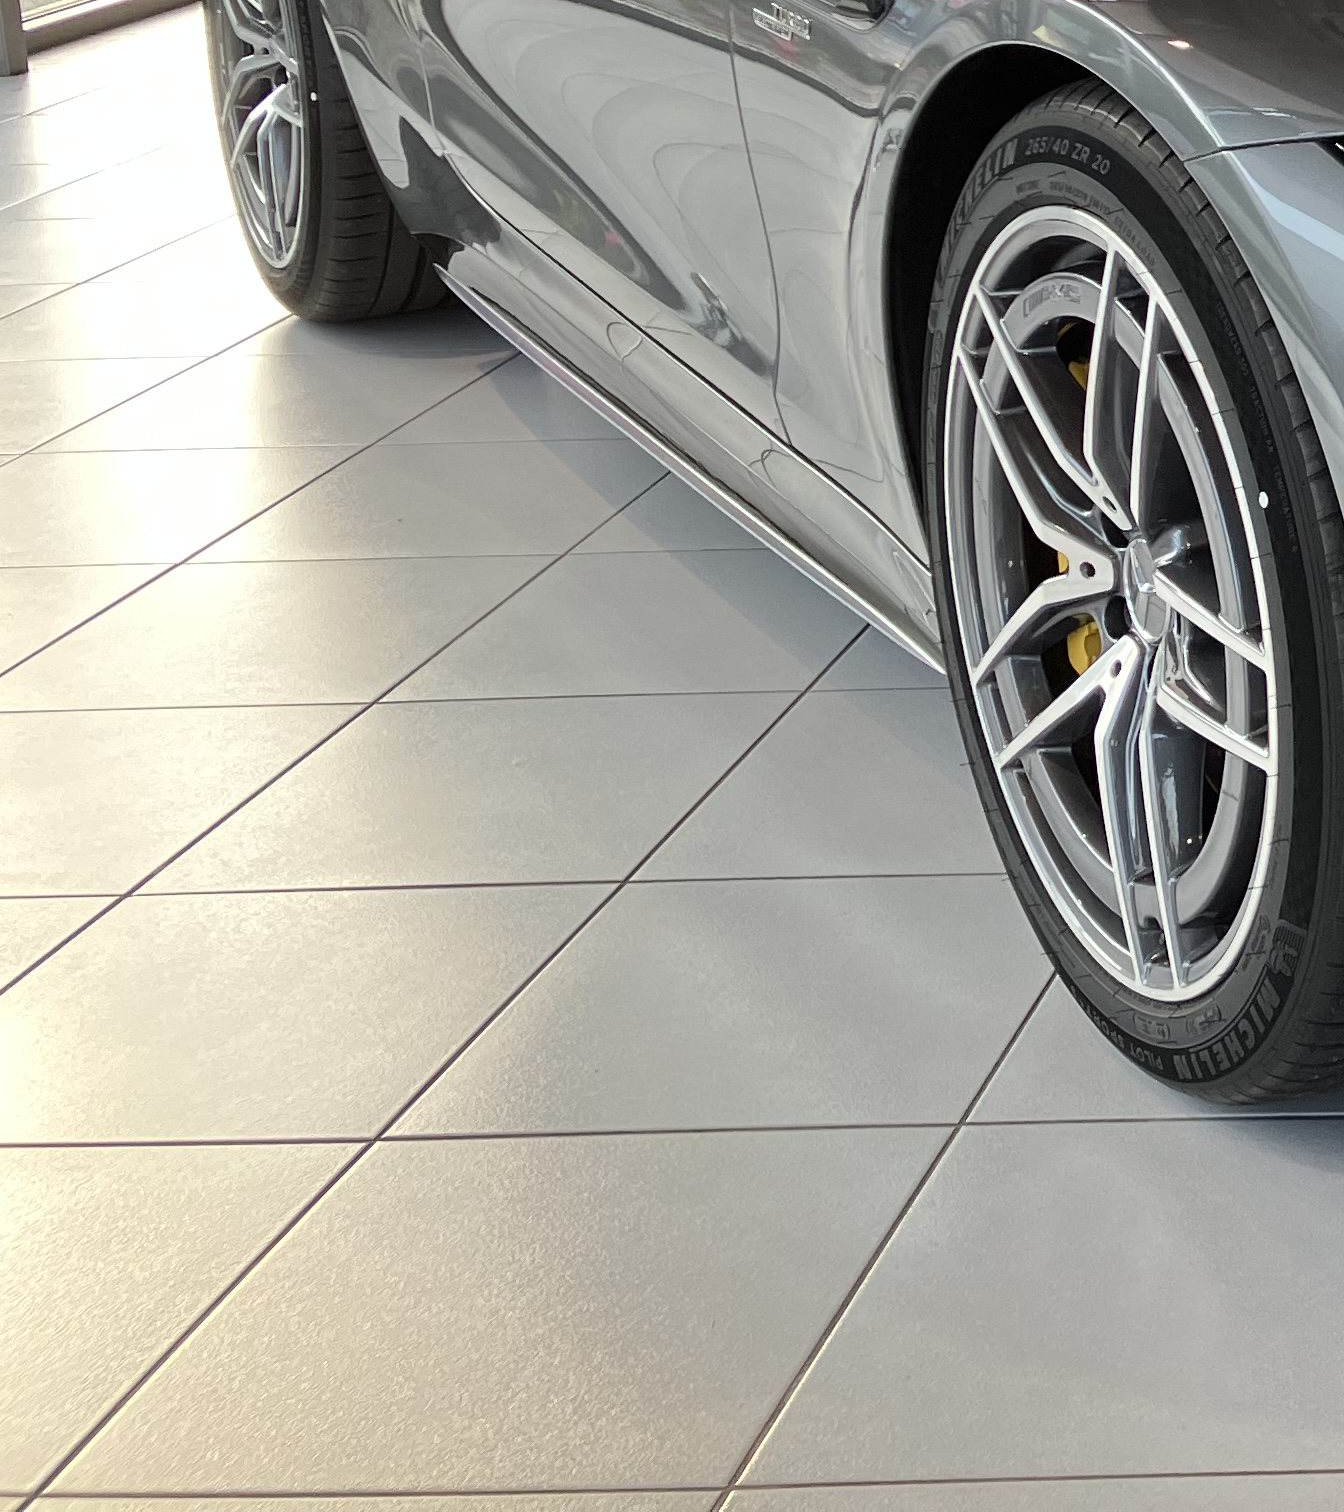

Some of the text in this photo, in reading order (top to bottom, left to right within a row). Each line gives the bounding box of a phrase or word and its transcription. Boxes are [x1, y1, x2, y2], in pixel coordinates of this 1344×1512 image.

[1025, 135, 1070, 156] 265/40
[1071, 142, 1091, 164] ZR
[1091, 154, 1111, 176] 20
[1172, 975, 1281, 1080] MICHELIN
[1130, 1042, 1165, 1071] PILOT
